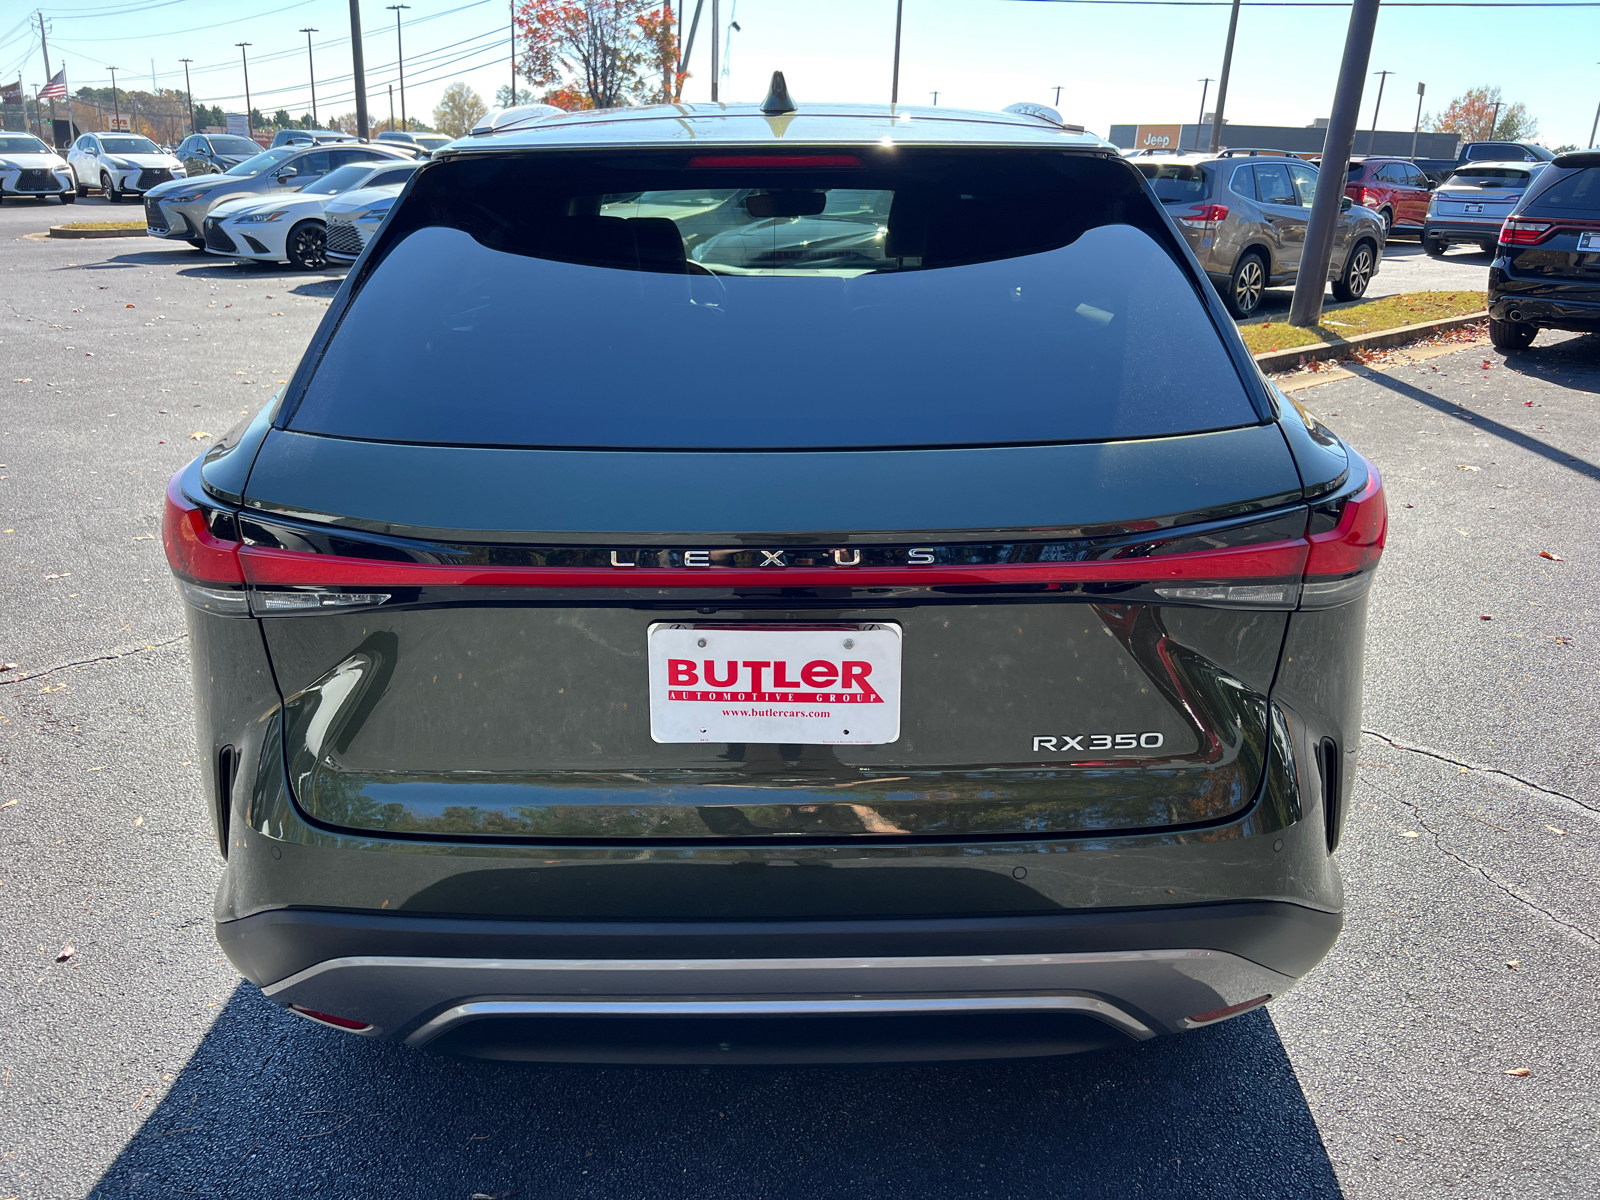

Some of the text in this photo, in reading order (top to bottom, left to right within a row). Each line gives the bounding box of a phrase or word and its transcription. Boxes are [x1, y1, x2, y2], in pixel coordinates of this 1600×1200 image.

[1143, 133, 1170, 148] Jeep
[610, 548, 935, 567] LEXUS
[669, 691, 877, 703] AUTOMOTIVE GROUP
[722, 708, 831, 718] www.butlercars.com
